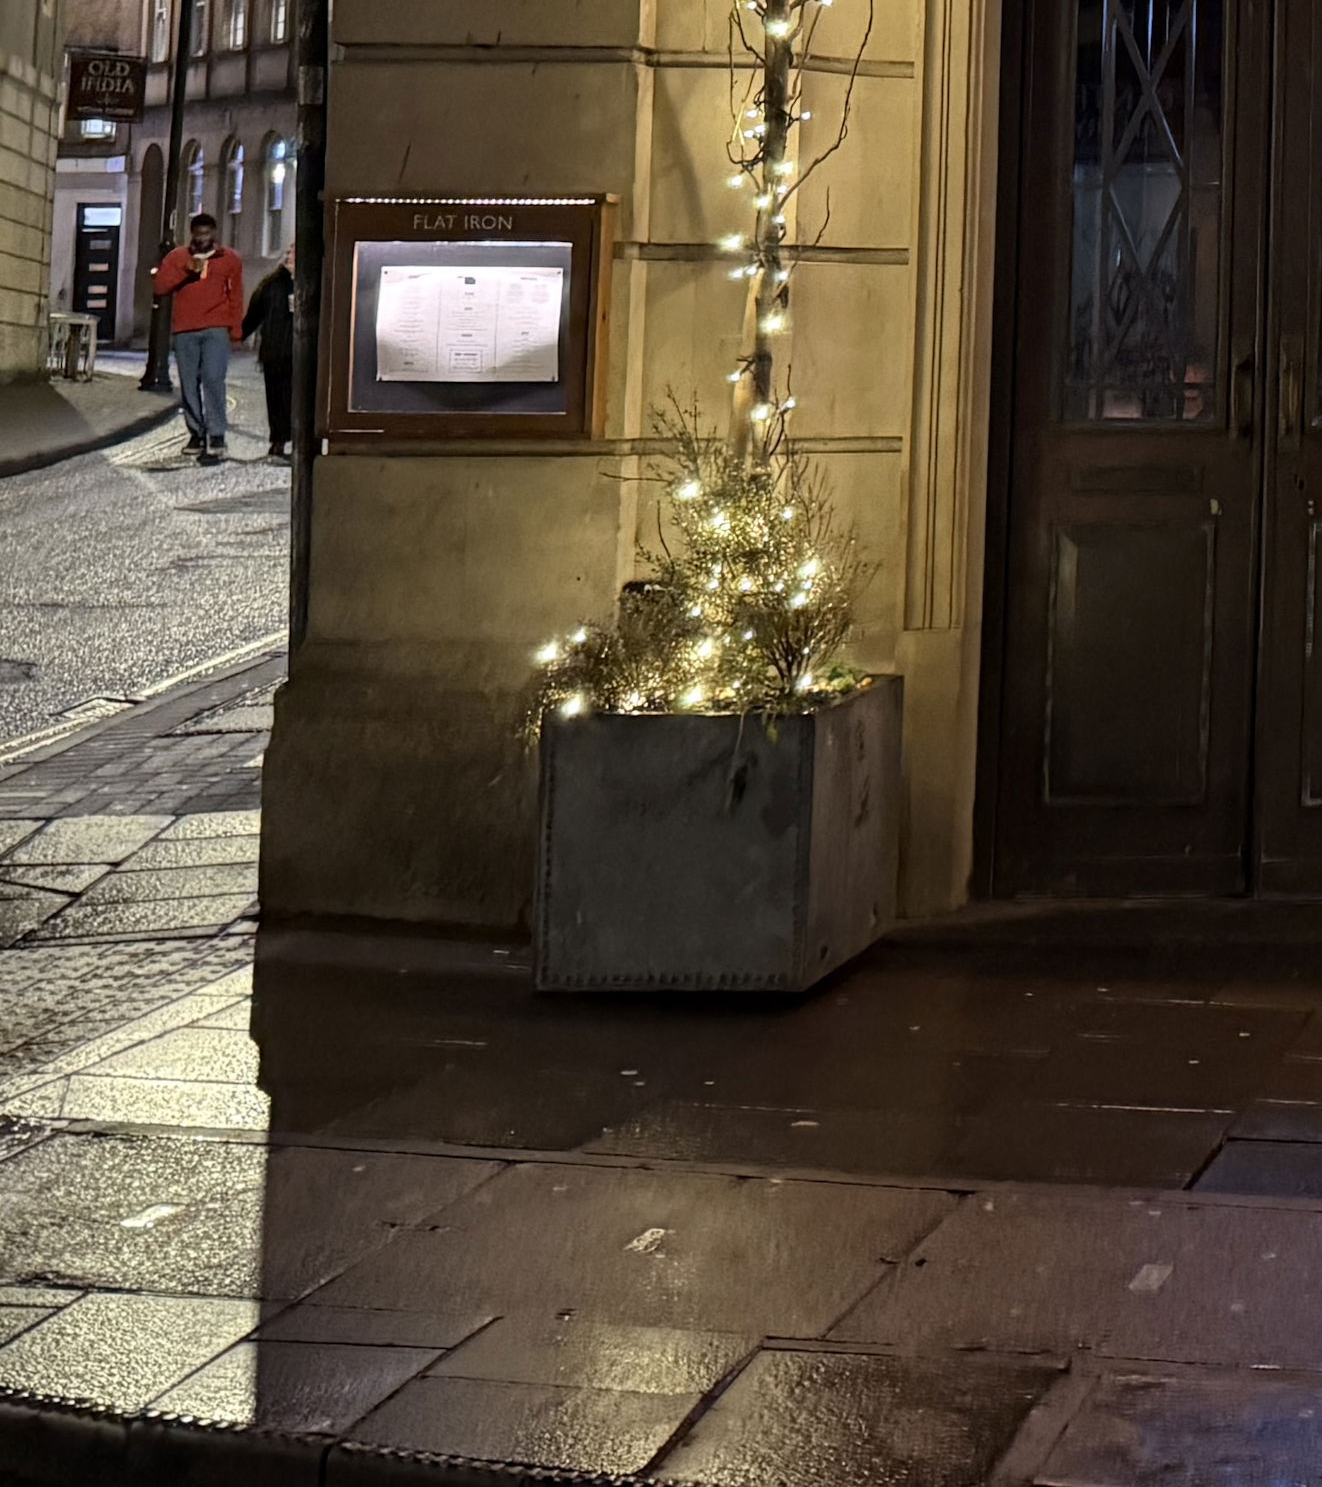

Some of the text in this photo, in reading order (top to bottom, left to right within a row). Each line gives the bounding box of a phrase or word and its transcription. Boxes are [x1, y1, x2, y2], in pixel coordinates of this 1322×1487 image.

[88, 59, 130, 77] OLD
[81, 76, 135, 93] INDIA
[413, 214, 513, 231] FLAT IRON
